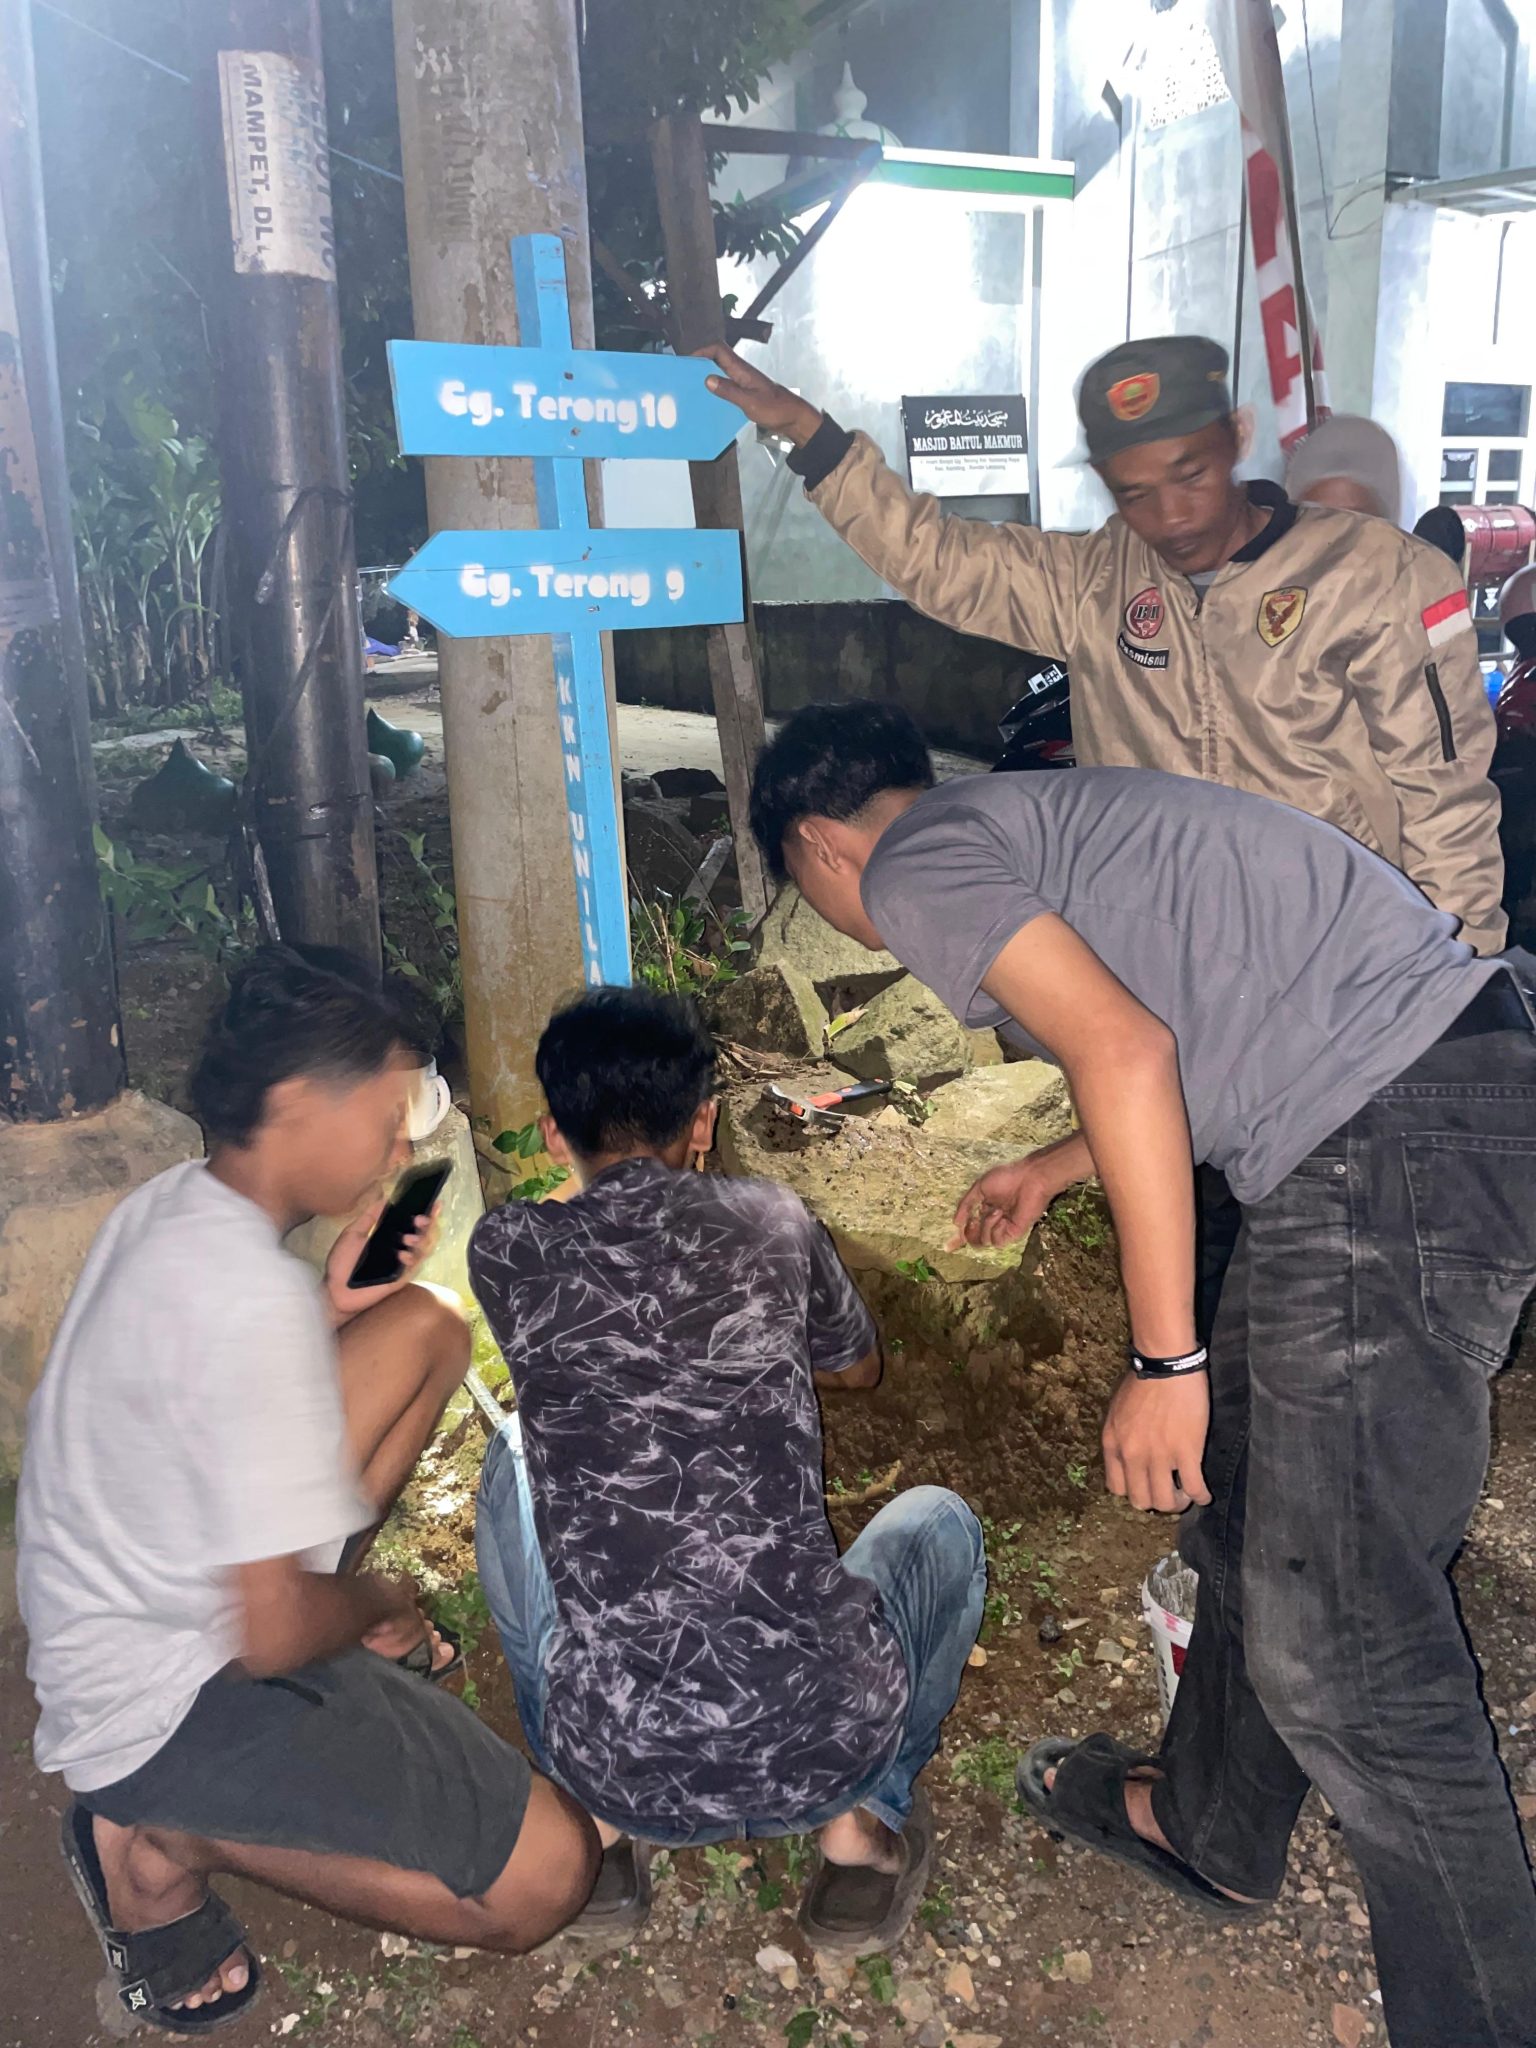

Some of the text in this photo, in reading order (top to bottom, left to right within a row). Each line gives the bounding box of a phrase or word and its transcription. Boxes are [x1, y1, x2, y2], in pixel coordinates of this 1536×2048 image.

[243, 64, 270, 195] MAMPET,
[440, 380, 504, 427] Gg.
[912, 435, 1023, 451] MASJID BAITUL MAKMUR
[460, 563, 685, 606] Gg. Terong 9
[558, 674, 602, 986] KKN UNILA
